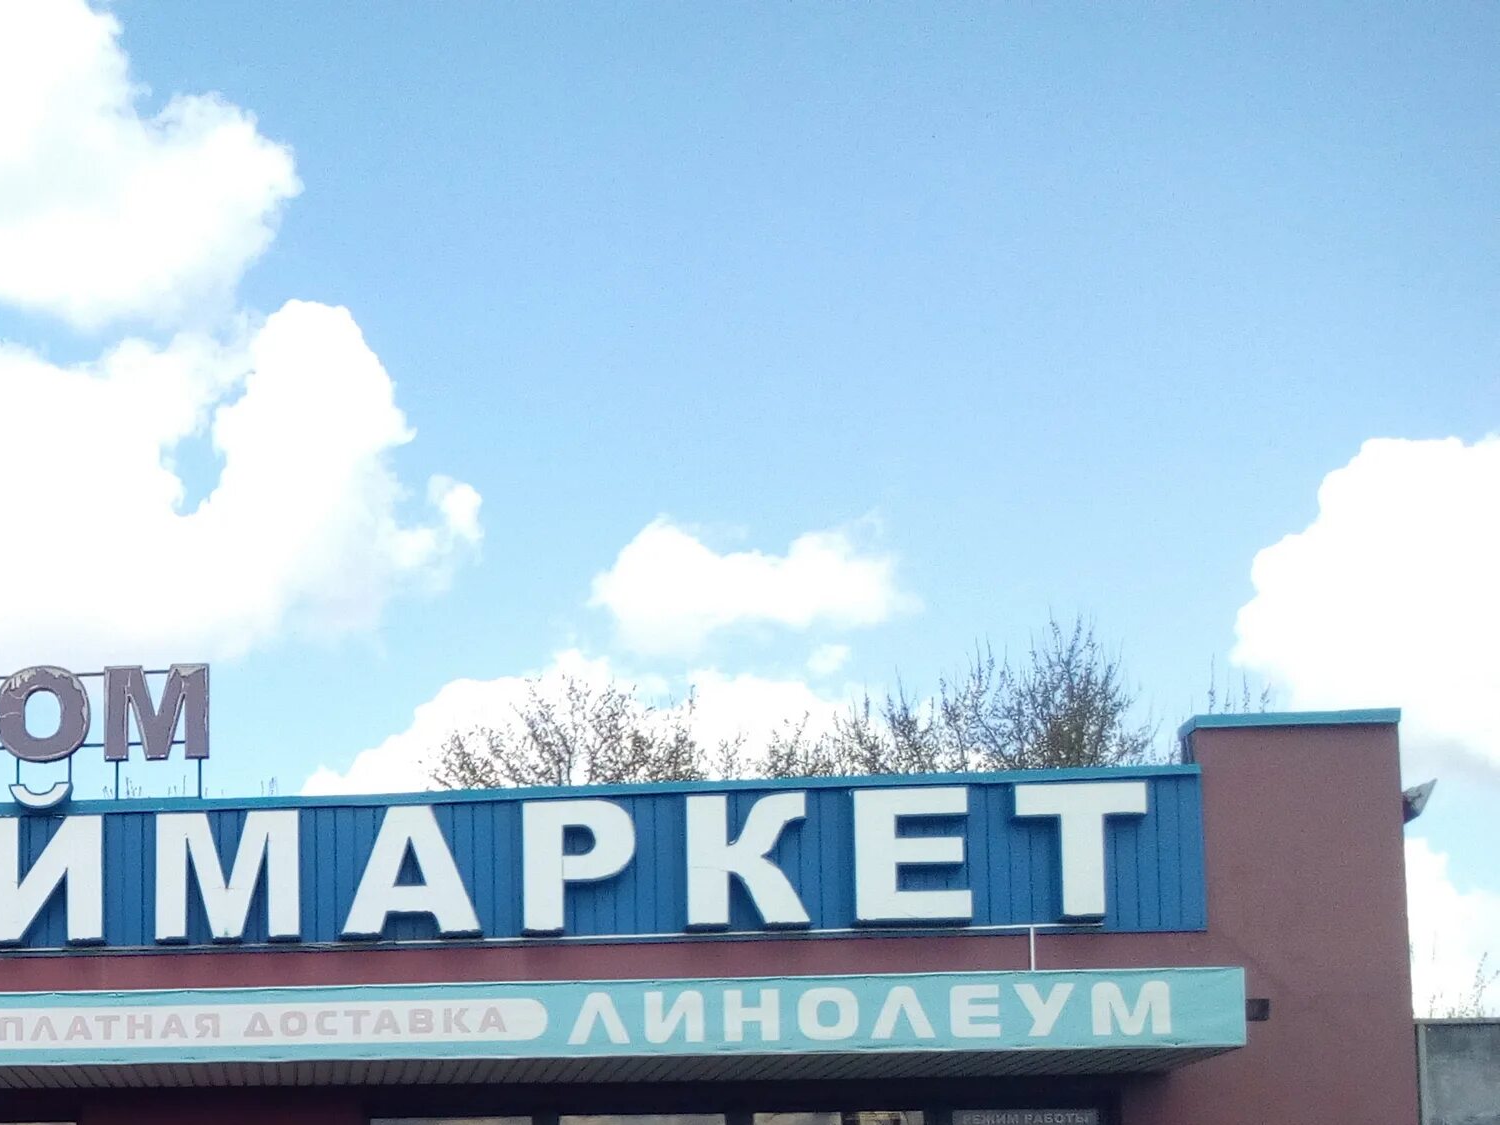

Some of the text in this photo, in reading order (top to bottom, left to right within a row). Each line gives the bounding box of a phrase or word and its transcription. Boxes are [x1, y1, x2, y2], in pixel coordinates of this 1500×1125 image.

[243, 1006, 509, 1037] ДОСТАВКА
[568, 981, 1173, 1046] ЛИНОЛЕУМ
[963, 1112, 1090, 1125] РЕЖИМ РАБОТЫ
